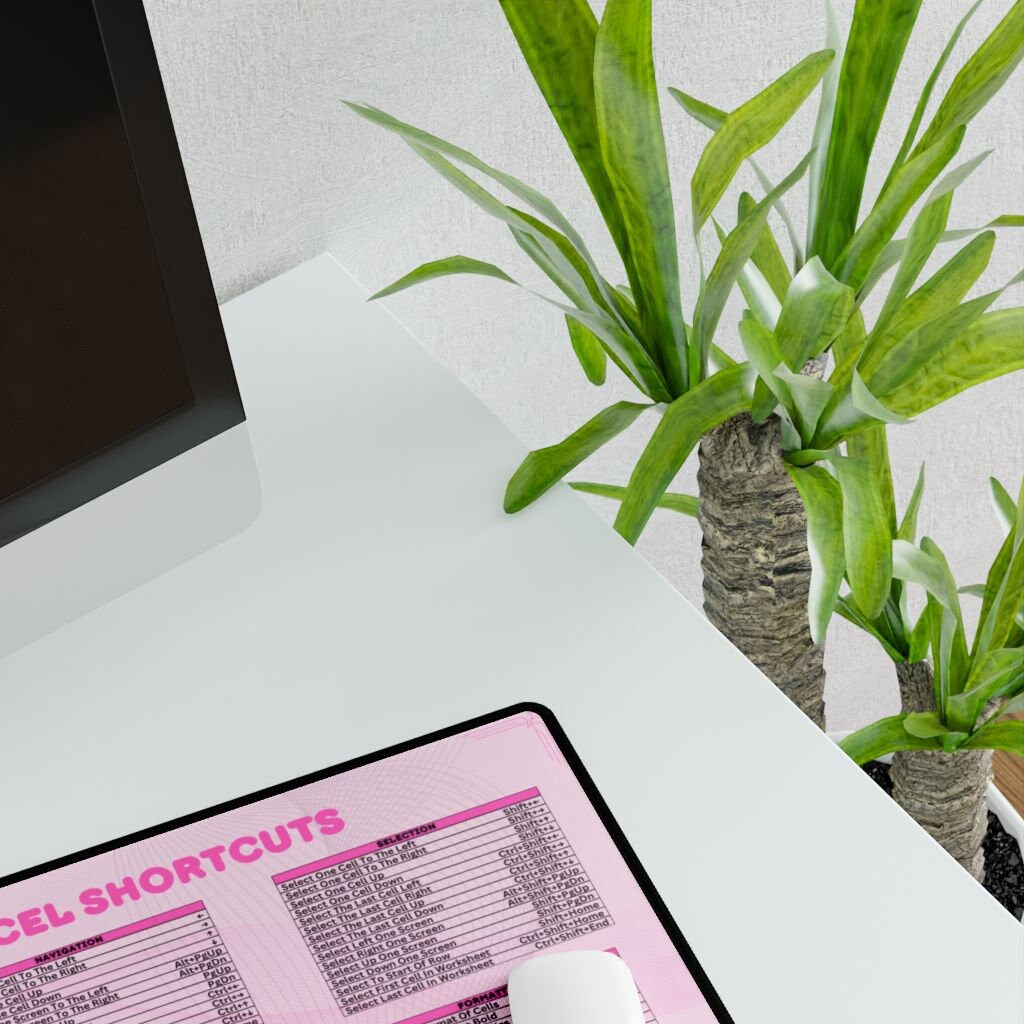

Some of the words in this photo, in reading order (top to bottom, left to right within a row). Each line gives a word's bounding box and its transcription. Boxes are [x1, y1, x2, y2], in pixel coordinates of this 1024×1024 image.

[375, 822, 437, 848] SELECTION
[78, 808, 346, 915] SHORTCUTS
[280, 874, 314, 891] Select
[314, 868, 337, 880] One
[337, 859, 359, 872] Cell
[359, 856, 374, 864] To
[374, 849, 394, 859] The
[394, 839, 417, 853] Left
[298, 909, 333, 926] Select
[333, 903, 353, 914] The
[353, 894, 377, 907] Last
[377, 887, 399, 899] Cell
[399, 879, 422, 892] Left
[32, 935, 105, 964] NAVIGATION
[321, 953, 355, 970] Select
[355, 943, 384, 958] Right
[384, 937, 408, 949] One
[407, 924, 446, 941] Screen
[18, 971, 33, 980] To
[33, 964, 54, 975] The
[54, 954, 78, 968] Left
[201, 965, 233, 979] PgUp
[206, 974, 237, 988] PgDn
[12, 1007, 50, 1024] Screen
[50, 1002, 65, 1011] To
[65, 994, 86, 1005] The
[86, 985, 110, 998] Left
[457, 1010, 472, 1020] Of
[471, 1002, 500, 1015] Cells
